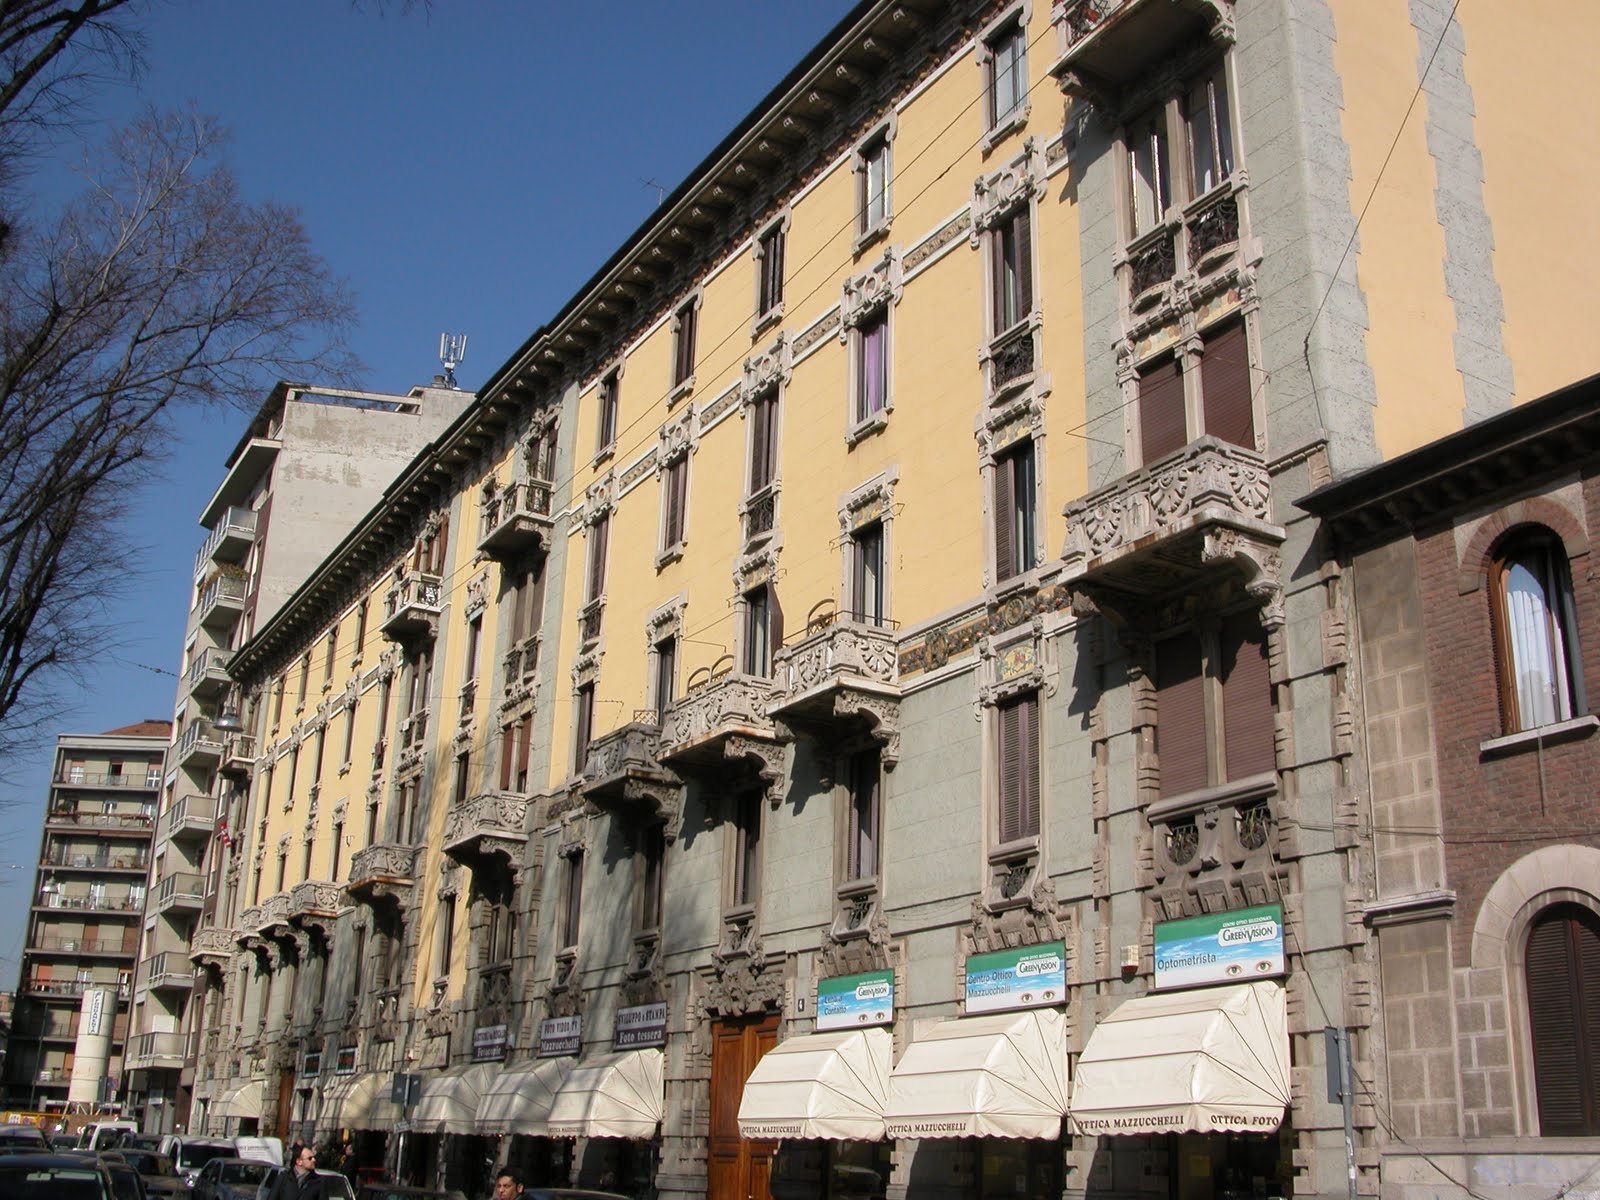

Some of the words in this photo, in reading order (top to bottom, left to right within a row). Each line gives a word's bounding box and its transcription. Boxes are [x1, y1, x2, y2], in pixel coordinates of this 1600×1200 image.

[1157, 952, 1216, 971] Optometrista
[968, 974, 990, 984] Centro
[992, 971, 1012, 981] Ottico
[968, 986, 1010, 998] Mazzucchelli
[646, 1008, 665, 1022] STAMPA
[542, 1036, 580, 1051] Mazzucchelli
[619, 1032, 635, 1044] Foto
[638, 1030, 662, 1041] tessera
[1078, 1119, 1111, 1130] OTTICA
[1113, 1116, 1185, 1128] MAZZUCCHELLI
[1210, 1114, 1248, 1125] OTTICA
[1251, 1116, 1280, 1126] FOTO
[741, 1125, 761, 1134] OTTICA
[762, 1125, 802, 1134] MAZZUCCHELLI
[887, 1124, 913, 1134] OTTICA
[914, 1122, 967, 1133] MAZZUCCHELLI
